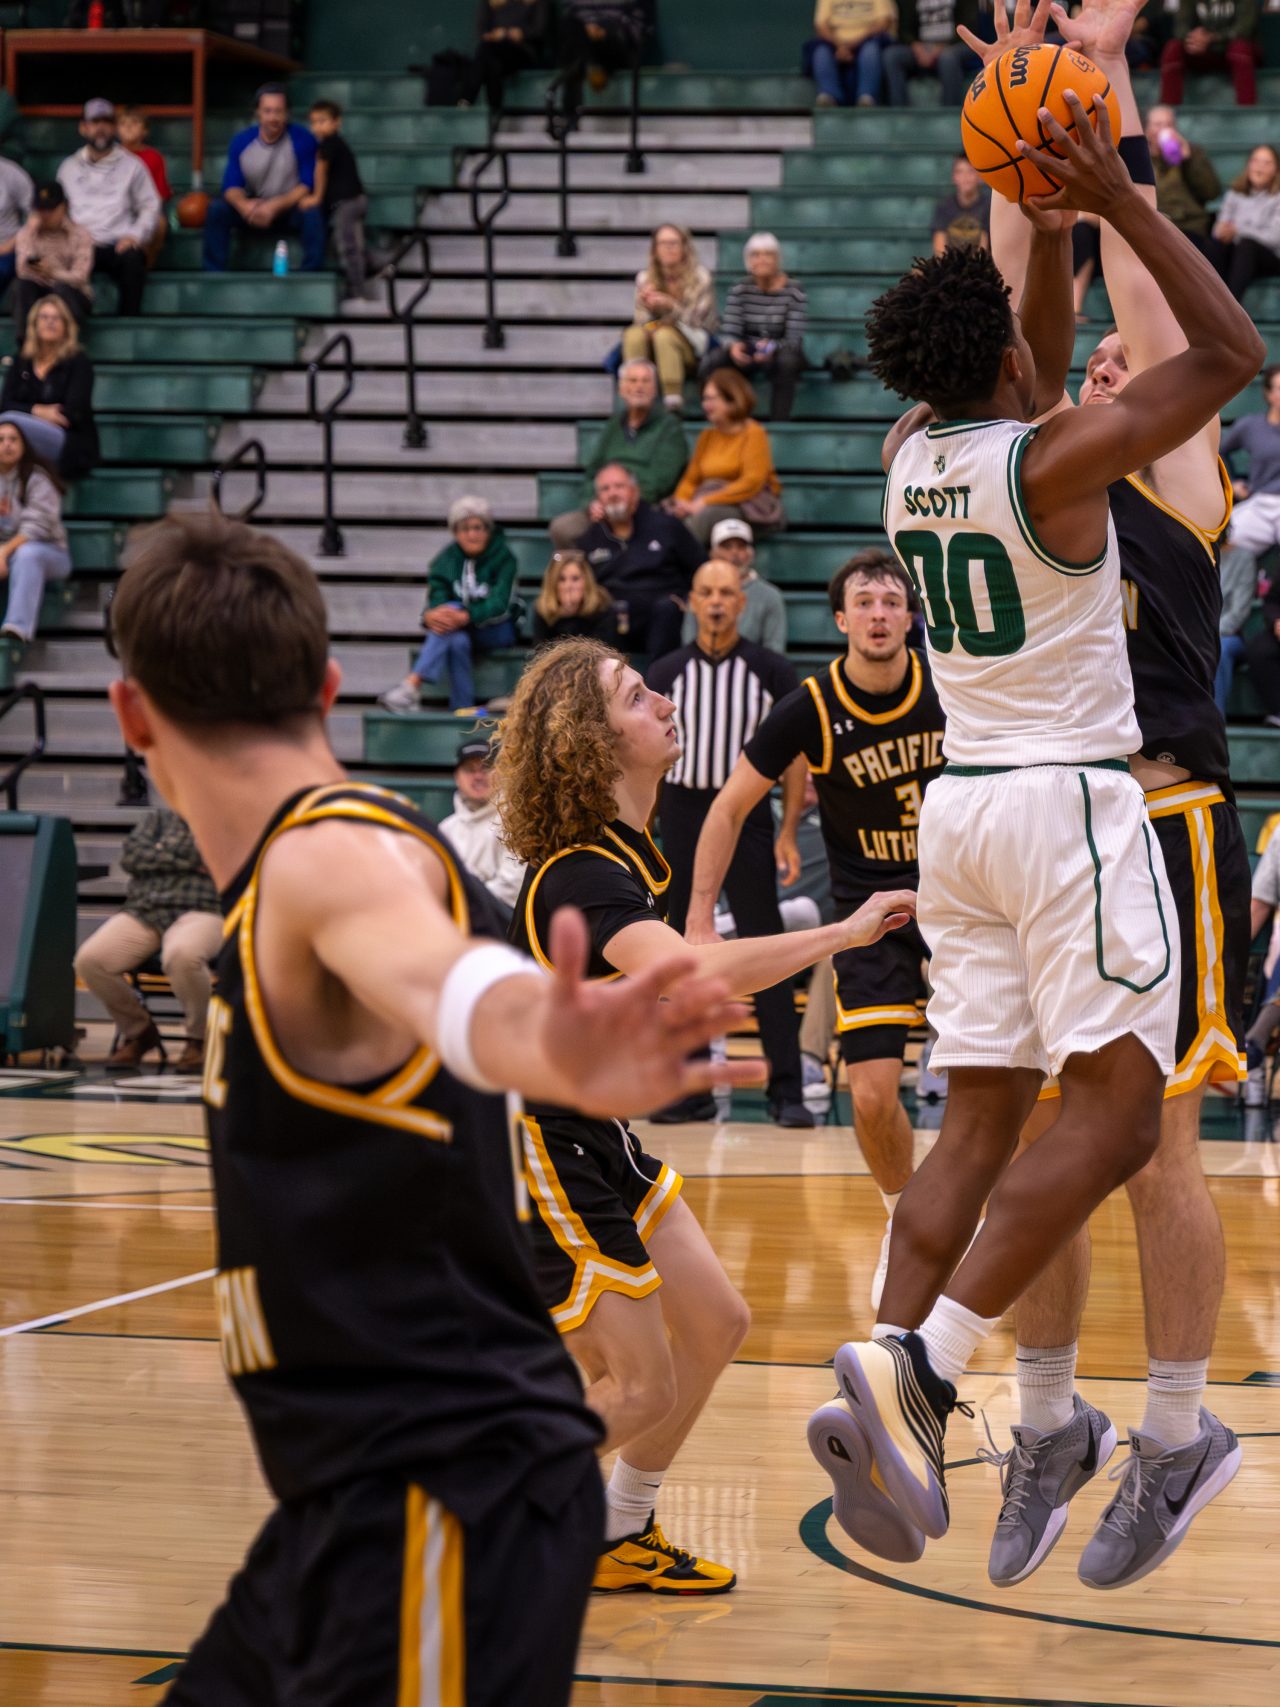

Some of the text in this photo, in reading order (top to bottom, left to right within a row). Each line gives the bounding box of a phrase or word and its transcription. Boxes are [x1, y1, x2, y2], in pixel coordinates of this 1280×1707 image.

[903, 484, 972, 519] SCOTT
[894, 529, 1027, 658] 00
[842, 730, 946, 789] PACIFIC
[894, 780, 922, 826] 3
